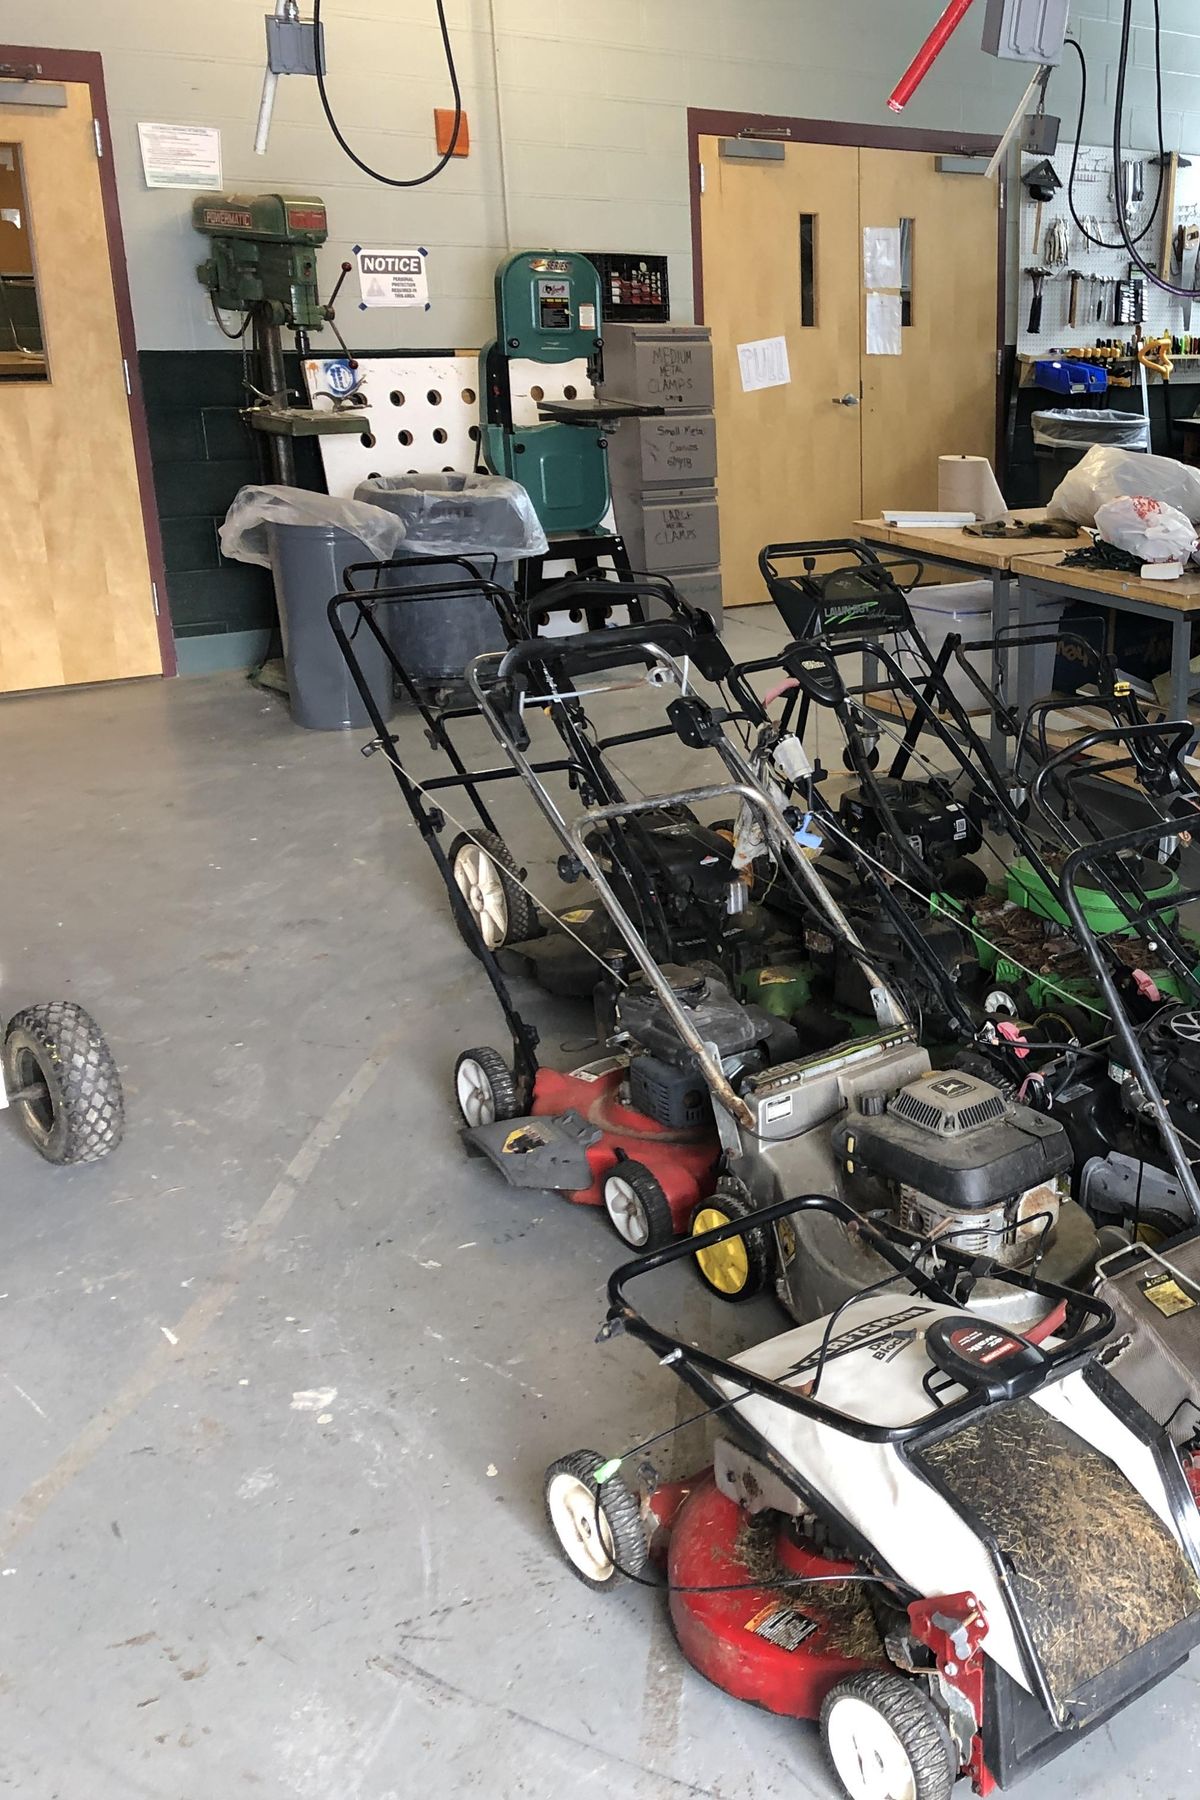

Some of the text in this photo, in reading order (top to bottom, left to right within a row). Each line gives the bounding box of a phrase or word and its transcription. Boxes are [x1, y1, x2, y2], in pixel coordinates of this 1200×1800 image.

[206, 211, 250, 226] POWERMATIC
[364, 257, 419, 272] NOTICE
[652, 347, 692, 364] MEDIUM
[648, 378, 693, 393] CLAMPS
[657, 425, 680, 436] Small
[656, 529, 697, 545] CLAMPS
[872, 1337, 906, 1361] Bloc
